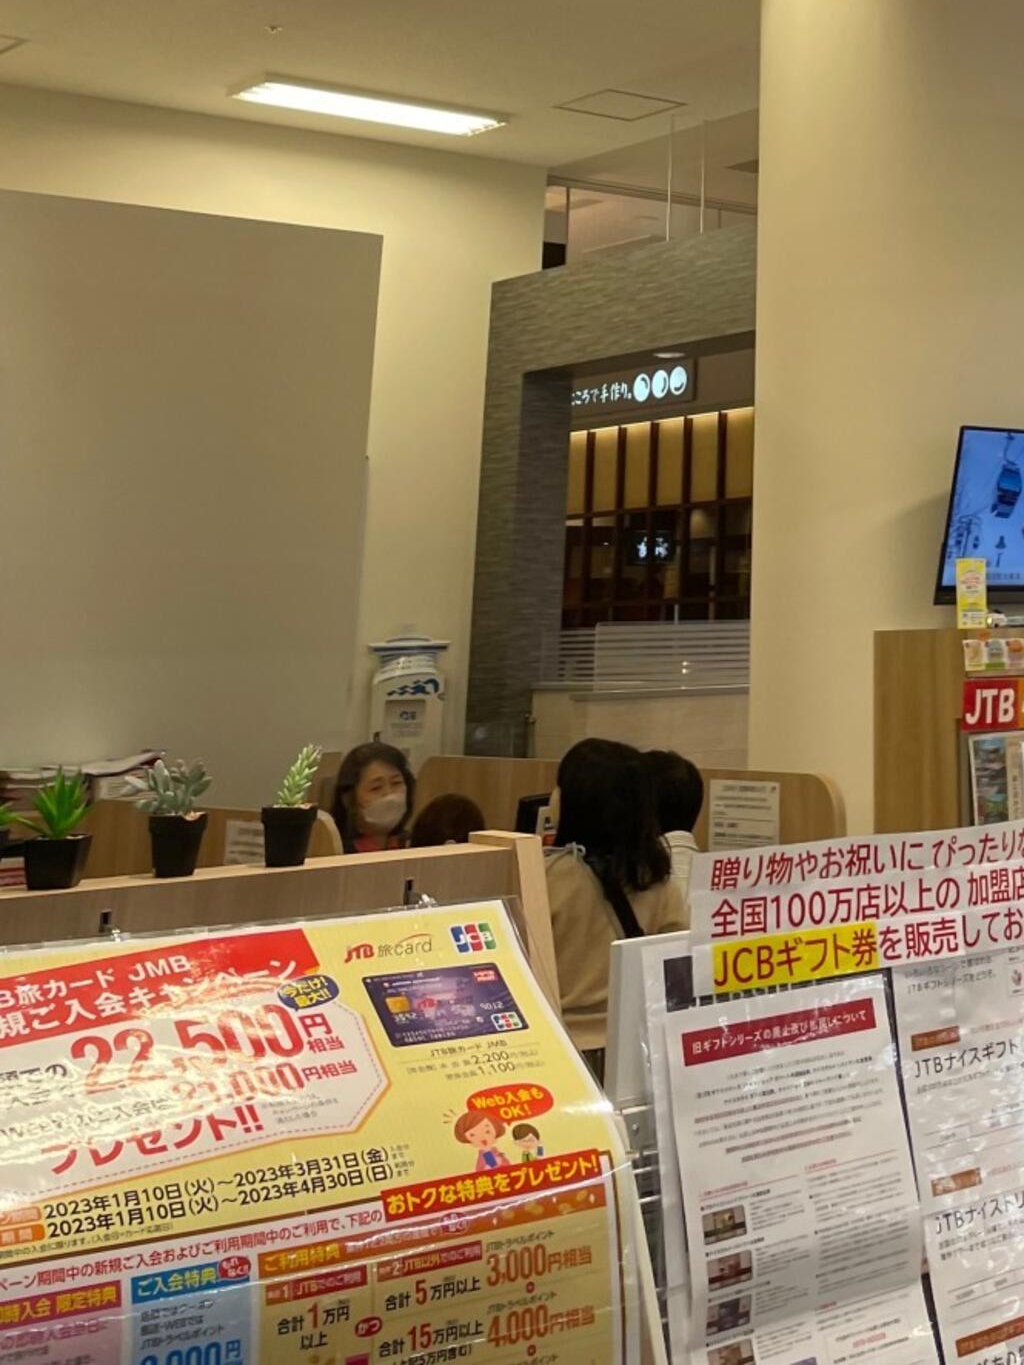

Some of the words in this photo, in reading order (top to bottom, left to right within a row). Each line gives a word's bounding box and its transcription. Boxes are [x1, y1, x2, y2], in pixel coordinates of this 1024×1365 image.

[571, 382, 632, 406] ころで手作り。
[965, 689, 1015, 725] JTB
[344, 943, 375, 963] JTB
[128, 954, 191, 982] JMB
[307, 1036, 344, 1053] 相当
[914, 1039, 1019, 1079] JTBナイスギフト
[471, 1088, 544, 1109] Web入会も
[500, 1104, 531, 1119] OK!
[387, 1155, 600, 1215] おトクな特典をプレゼント!
[138, 1267, 217, 1296] ご入会特典
[300, 1331, 328, 1350] 以上
